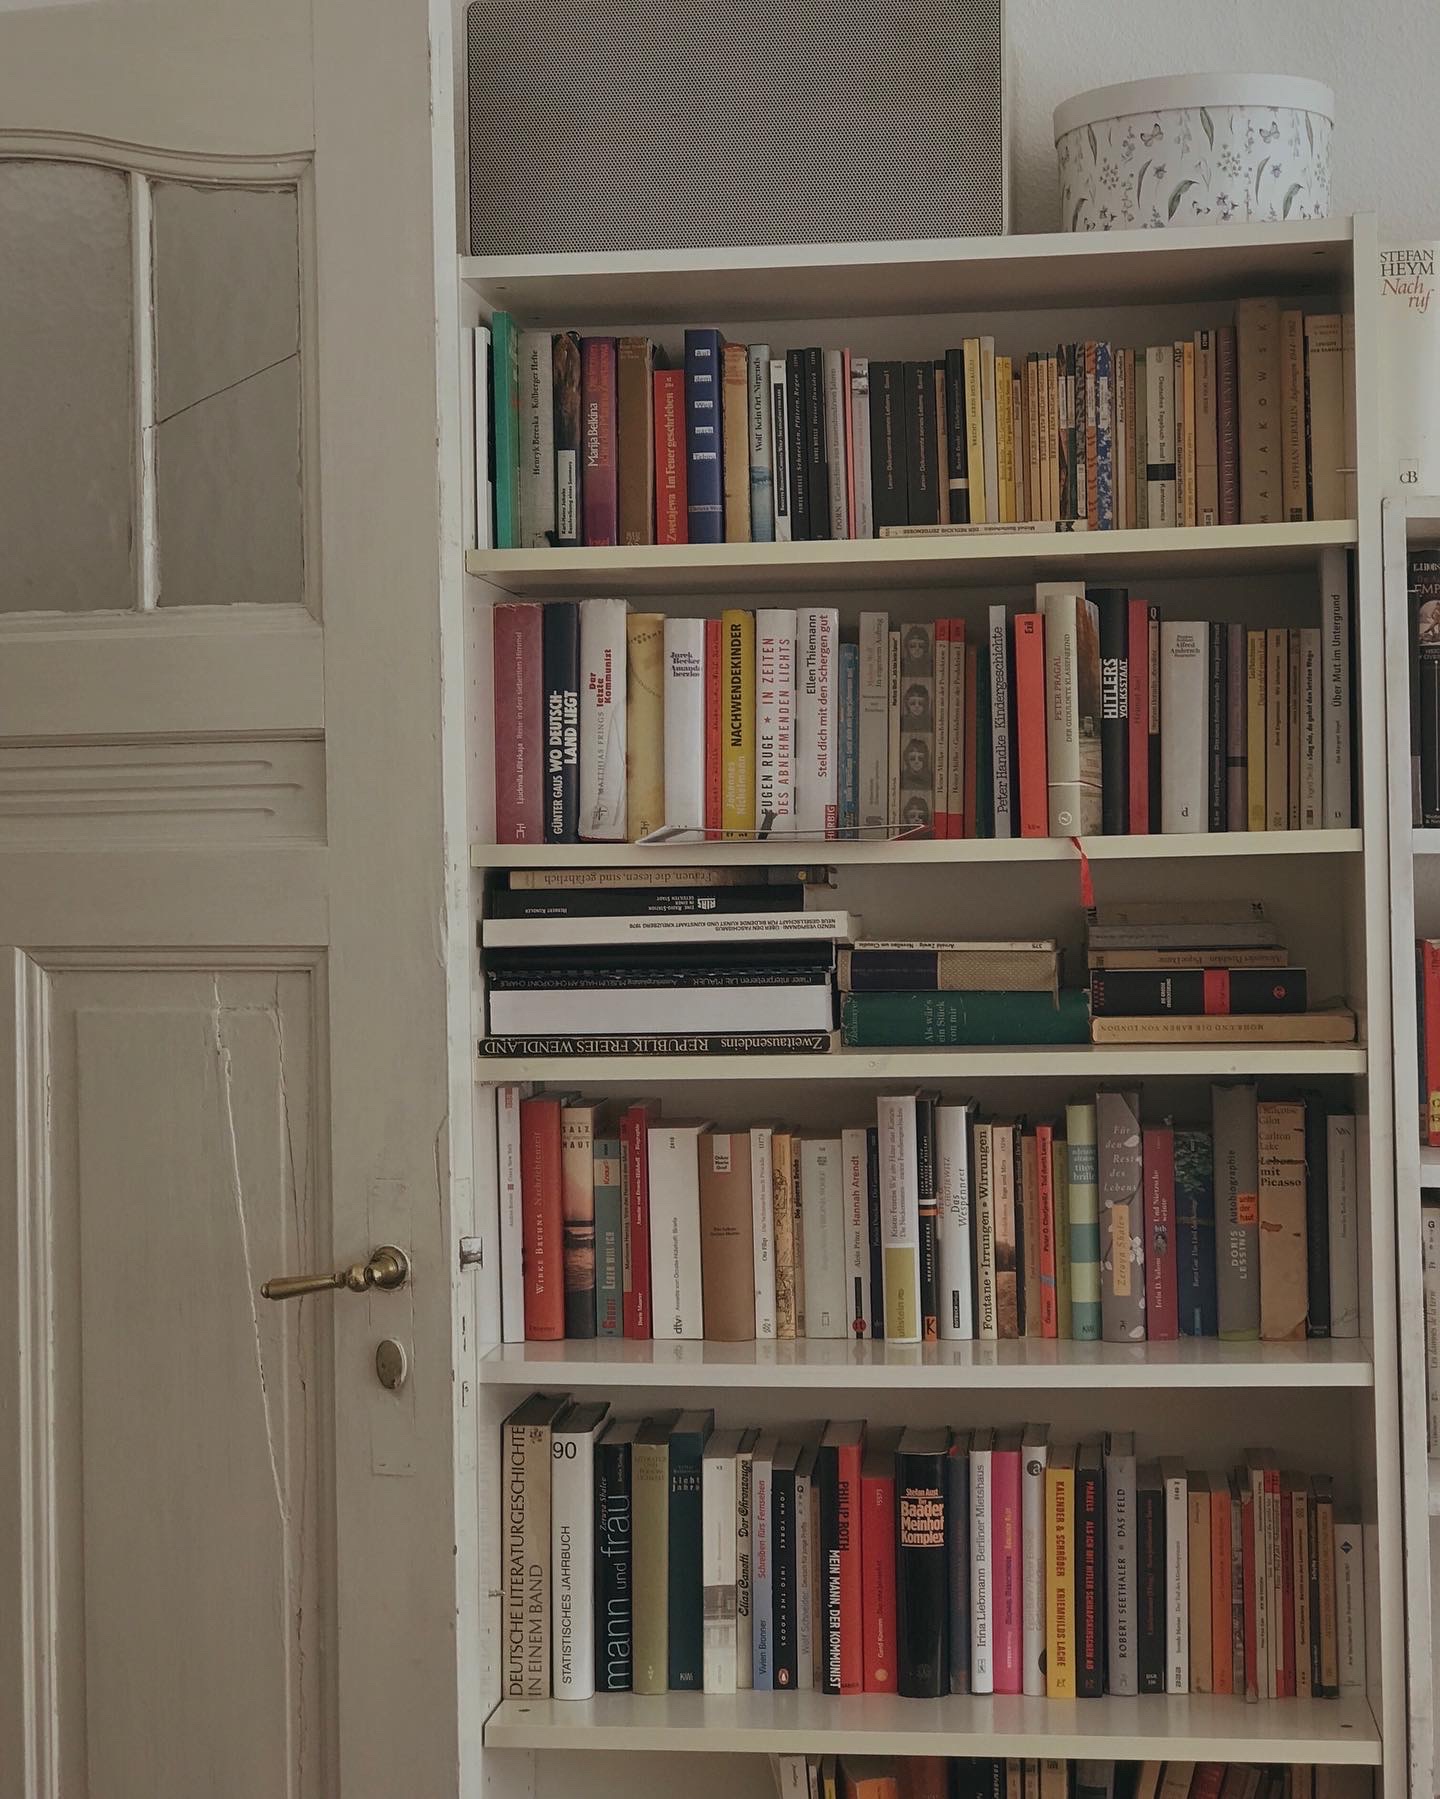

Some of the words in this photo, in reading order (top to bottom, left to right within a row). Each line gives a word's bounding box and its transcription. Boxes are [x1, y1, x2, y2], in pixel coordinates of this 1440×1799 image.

[1380, 250, 1434, 263] STEFAN
[1381, 262, 1434, 276] HEYM
[1382, 276, 1424, 296] Nach
[1407, 288, 1431, 314] ruf
[531, 372, 540, 408] Kolberger
[752, 357, 762, 393] Nirgends
[587, 403, 598, 435] Belkina
[664, 393, 677, 447] geschrieben
[754, 411, 762, 430] Kein
[588, 437, 599, 467] Marija
[754, 434, 762, 452] Wolf
[532, 446, 540, 475] Henryk
[665, 449, 676, 474] Feuer
[666, 476, 676, 488] Im
[666, 494, 678, 542] Zwetajewa
[833, 506, 842, 530] DORN
[820, 615, 830, 632] gut
[1331, 594, 1343, 647] Untergrund
[807, 615, 816, 667] Thiemann
[1332, 649, 1341, 661] im
[762, 638, 774, 683] ZEITEN
[778, 638, 790, 682] LICHTS
[819, 635, 829, 683] Schergen
[1332, 663, 1342, 682] Mut
[604, 649, 612, 704] Kommunist
[730, 623, 742, 747] NACHWENDEKINDER
[807, 668, 816, 694] Ellen
[993, 626, 1007, 729] Kindergeschichte
[1103, 658, 1117, 719] HITLERS
[1120, 659, 1128, 718] VOLKSSTAAT
[564, 691, 577, 725] LIEGT
[762, 692, 773, 704] IN
[819, 685, 828, 705] den
[1054, 694, 1062, 720] PETER
[1331, 685, 1342, 707] Über
[549, 690, 562, 745] DEUTSCH-
[819, 707, 828, 727] mit
[565, 728, 577, 764] LAND
[761, 735, 773, 766] RUGE
[778, 690, 789, 784] ABNEHMENDEN
[819, 729, 828, 751] dich
[550, 750, 562, 772] WO
[597, 749, 605, 795] MATTHIAS
[818, 753, 828, 777] Stell
[996, 735, 1007, 780] Handke
[516, 774, 524, 804] Ljudmila
[552, 775, 563, 798] GAUS
[726, 762, 736, 809] Johannes
[761, 774, 773, 815] EUGEN
[997, 781, 1008, 813] Peter
[552, 799, 563, 834] GÜNTER
[778, 792, 789, 815] DES
[544, 873, 597, 884] gefährlich
[599, 873, 622, 883] sind
[623, 872, 652, 883] lesen,
[655, 872, 671, 883] die
[673, 871, 712, 882] Frauen,
[697, 898, 716, 910] RIAS
[485, 1041, 574, 1054] WENDLAND
[577, 1040, 629, 1052] FREIES
[632, 1039, 708, 1052] REPUBLIK
[721, 1037, 823, 1050] Zweitausendeins
[850, 1155, 860, 1188] Arendt
[979, 1131, 989, 1199] Wirrungen
[1261, 1166, 1280, 1176] mit
[1227, 1150, 1238, 1224] Autobiographie
[1261, 1177, 1302, 1188] Picasso
[852, 1191, 861, 1226] Hannah
[951, 1194, 960, 1213] Das
[980, 1211, 991, 1268] Irrungen
[1230, 1230, 1239, 1266] DORIS
[1239, 1230, 1248, 1279] LESSING
[982, 1279, 992, 1330] Fontane
[673, 1318, 683, 1334] dtv
[552, 1441, 576, 1459] 90
[757, 1480, 765, 1520] Fernsehen
[839, 1481, 849, 1518] PHILIP
[976, 1465, 985, 1517] Mietshaus
[1056, 1481, 1065, 1522] KALENDER
[1117, 1488, 1125, 1513] FELD
[510, 1426, 525, 1607] LITERATURGESCHICHTE
[901, 1501, 945, 1516] Baader
[902, 1516, 945, 1531] Meinhof
[600, 1494, 630, 1558] frau
[738, 1518, 749, 1538] Der
[757, 1522, 766, 1538] fürs
[839, 1521, 849, 1551] ROTH
[901, 1530, 945, 1545] Komplex
[976, 1520, 985, 1562] Berliner
[1117, 1518, 1126, 1537] DAS
[560, 1526, 571, 1591] JAHRBUCH
[758, 1541, 766, 1579] Schreiben
[829, 1549, 841, 1574] MEIN
[1056, 1534, 1067, 1577] SCHRÖDER
[612, 1562, 627, 1590] und
[738, 1553, 749, 1589] Canetti
[1117, 1558, 1126, 1614] SEETHALER
[528, 1564, 543, 1614] BAND
[738, 1590, 749, 1616] Elias
[828, 1576, 841, 1608] MANN,
[976, 1568, 986, 1621] Liebmann
[800, 1592, 810, 1633] Schneider
[829, 1609, 841, 1629] DER
[1056, 1588, 1067, 1639] KRIEMHILDS
[528, 1619, 543, 1673] EINEM
[561, 1594, 572, 1684] STATISTISCHES
[607, 1598, 630, 1689] mann
[758, 1620, 767, 1650] Bronner
[800, 1634, 810, 1654] Wolf
[977, 1622, 986, 1647] Irina
[1118, 1619, 1127, 1658] ROBERT
[509, 1612, 525, 1695] DEUTSCHE
[758, 1651, 767, 1675] Vivien
[829, 1631, 841, 1688] KOMMUNIST
[1056, 1642, 1066, 1667] LACHE
[528, 1677, 543, 1696] IN
